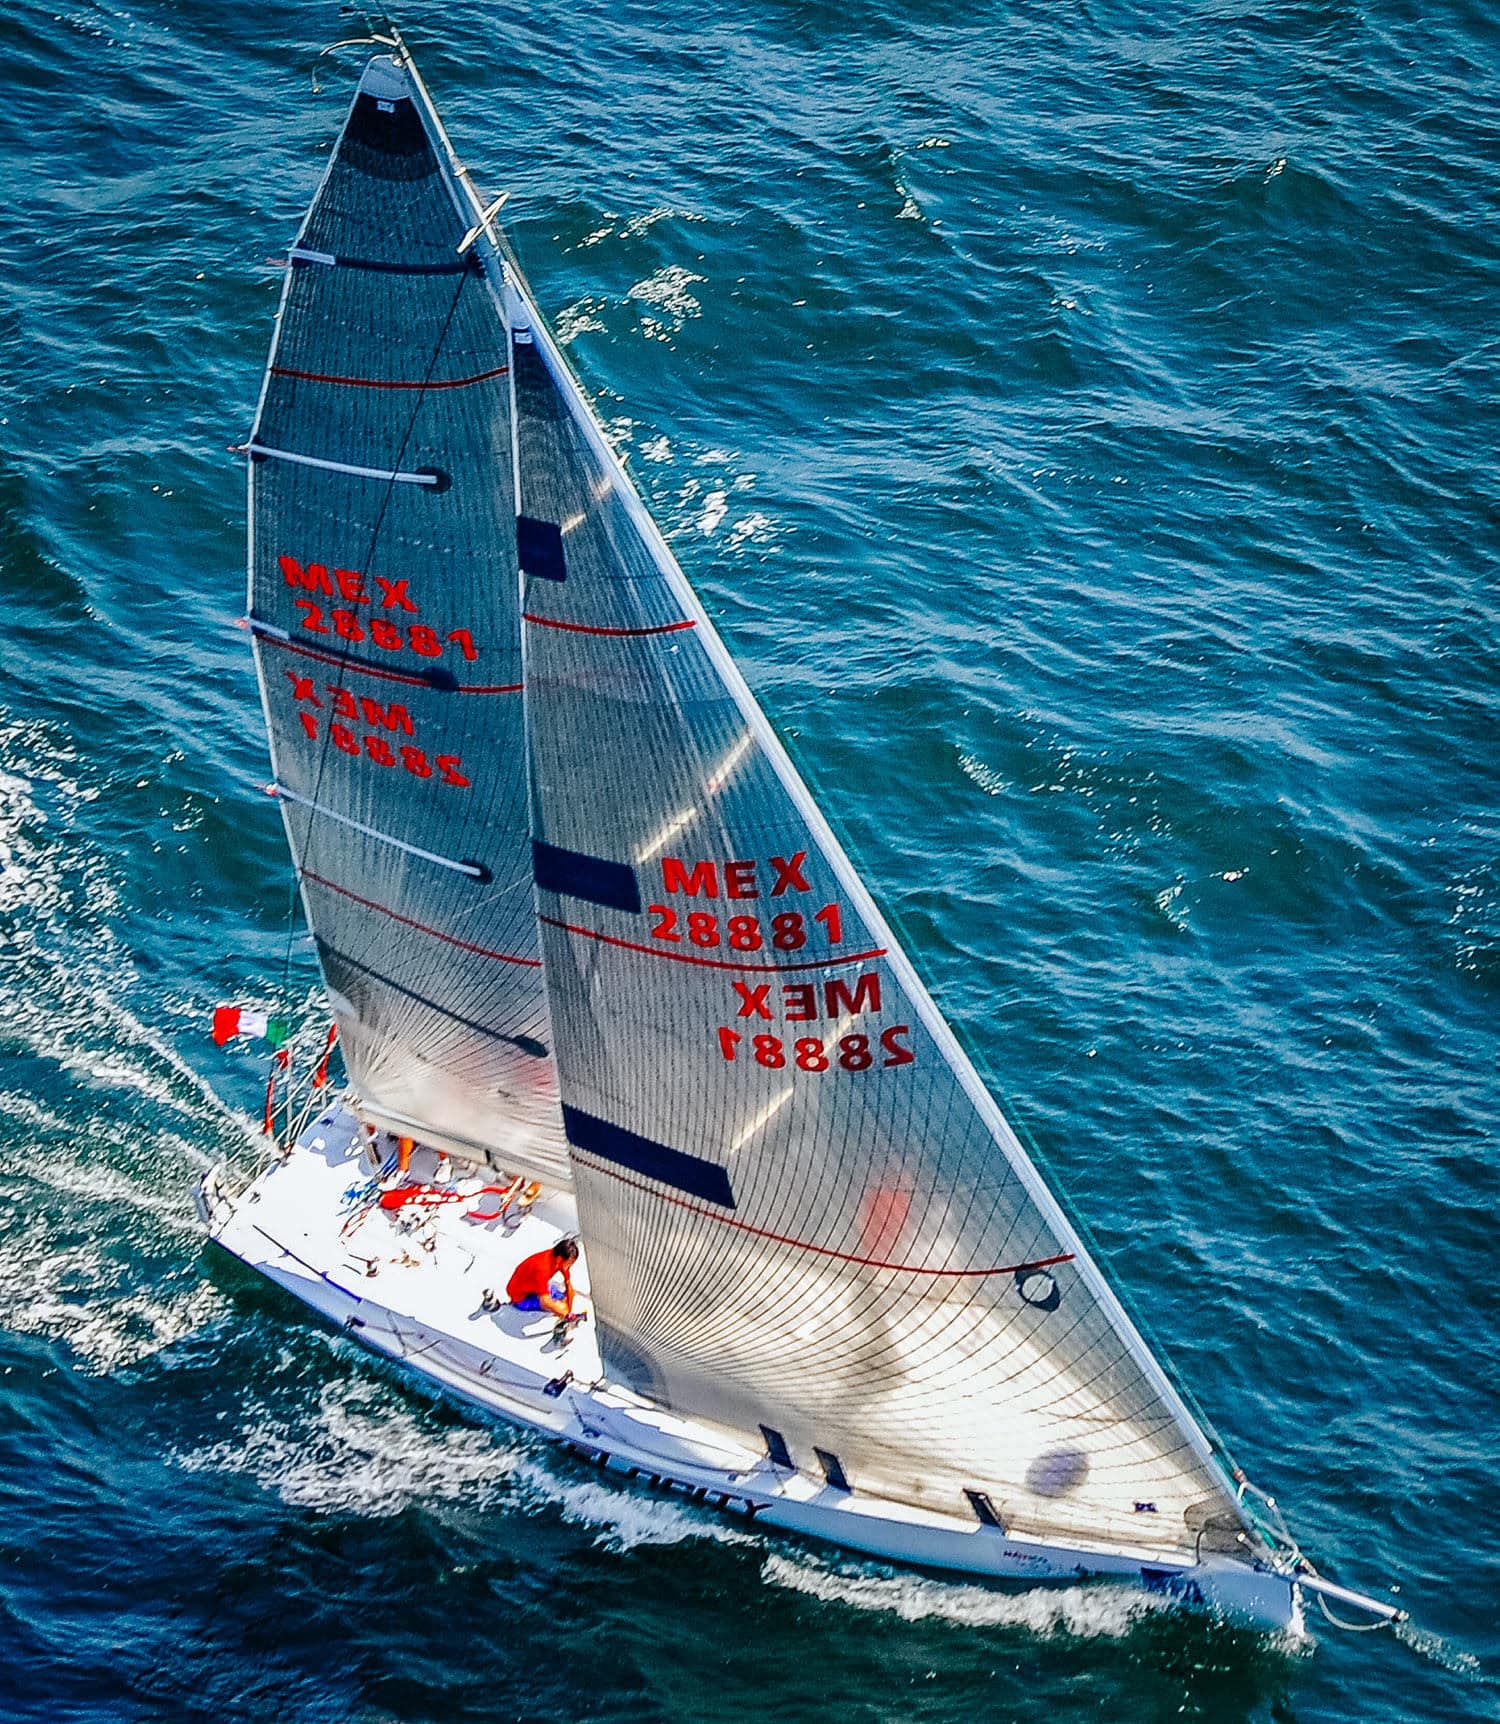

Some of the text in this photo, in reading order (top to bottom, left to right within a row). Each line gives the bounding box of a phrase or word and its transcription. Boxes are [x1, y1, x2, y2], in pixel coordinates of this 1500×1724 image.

[278, 555, 419, 613] MEX
[294, 599, 479, 661] 28881
[661, 851, 811, 900] MEX
[647, 903, 843, 951] 28881
